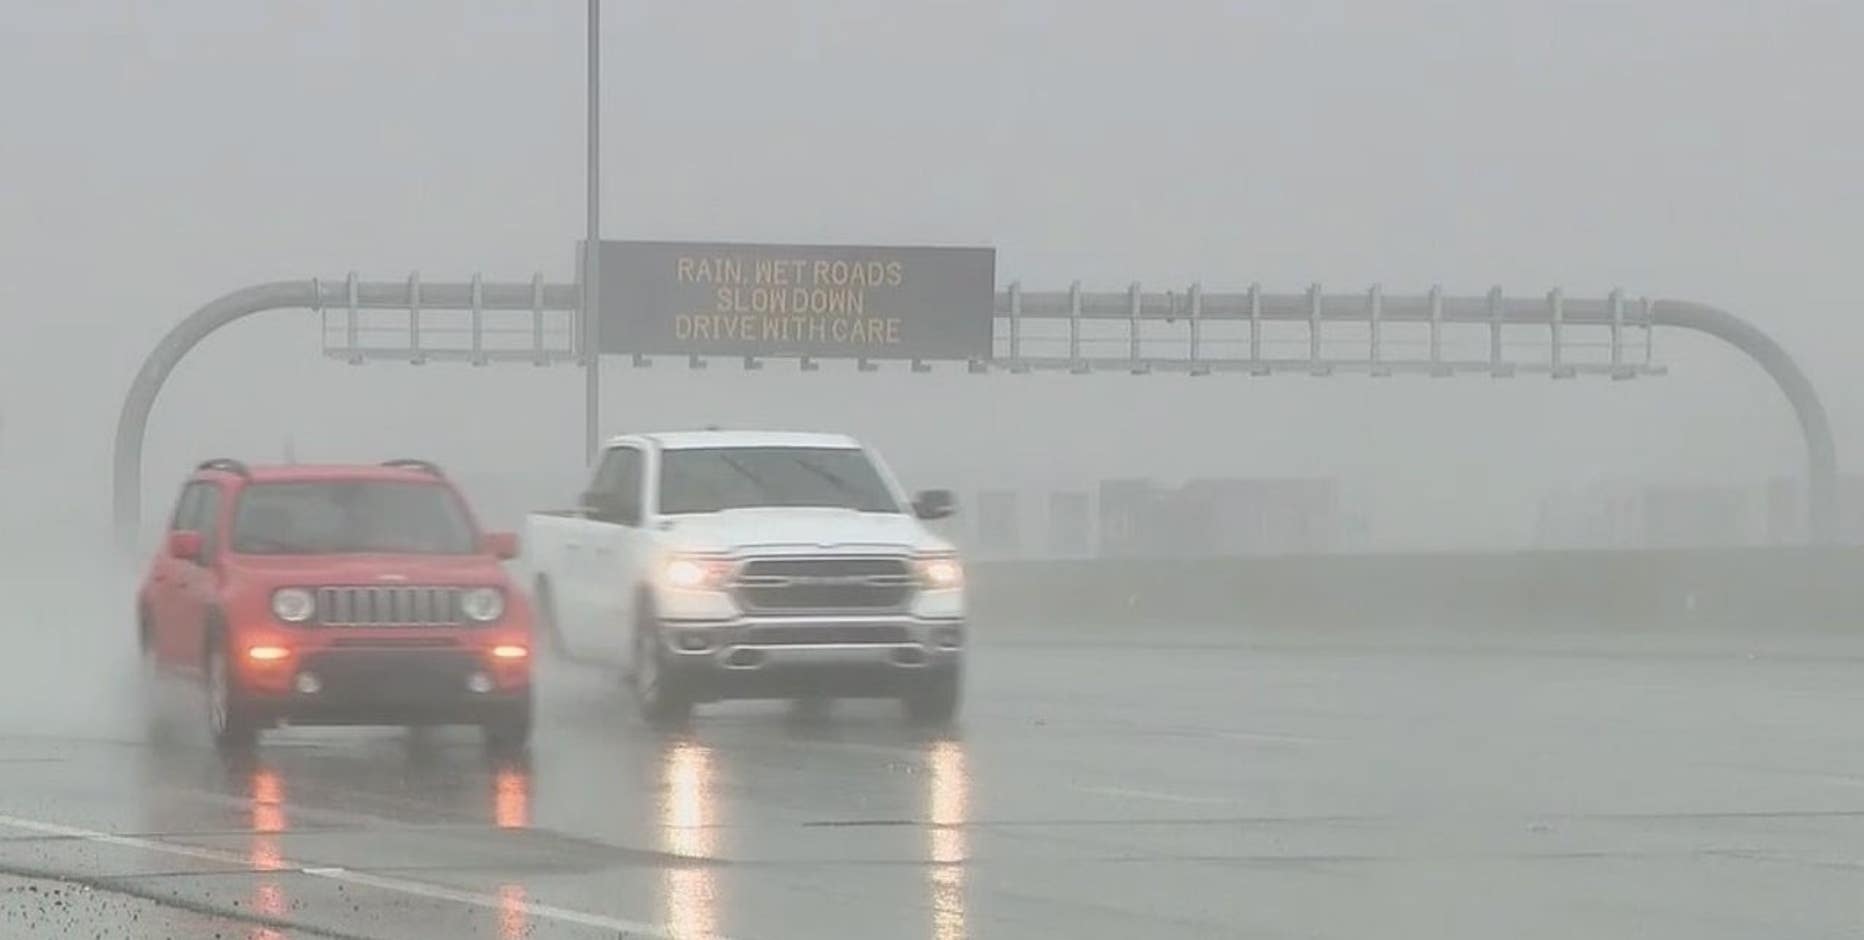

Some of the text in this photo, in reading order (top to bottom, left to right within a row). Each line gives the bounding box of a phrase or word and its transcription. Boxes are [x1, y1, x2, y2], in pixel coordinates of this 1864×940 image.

[756, 259, 807, 285] WET
[814, 260, 902, 287] ROADS
[717, 287, 864, 315] SLOW DOWN
[676, 314, 902, 343] DRIVE WITH CARE
